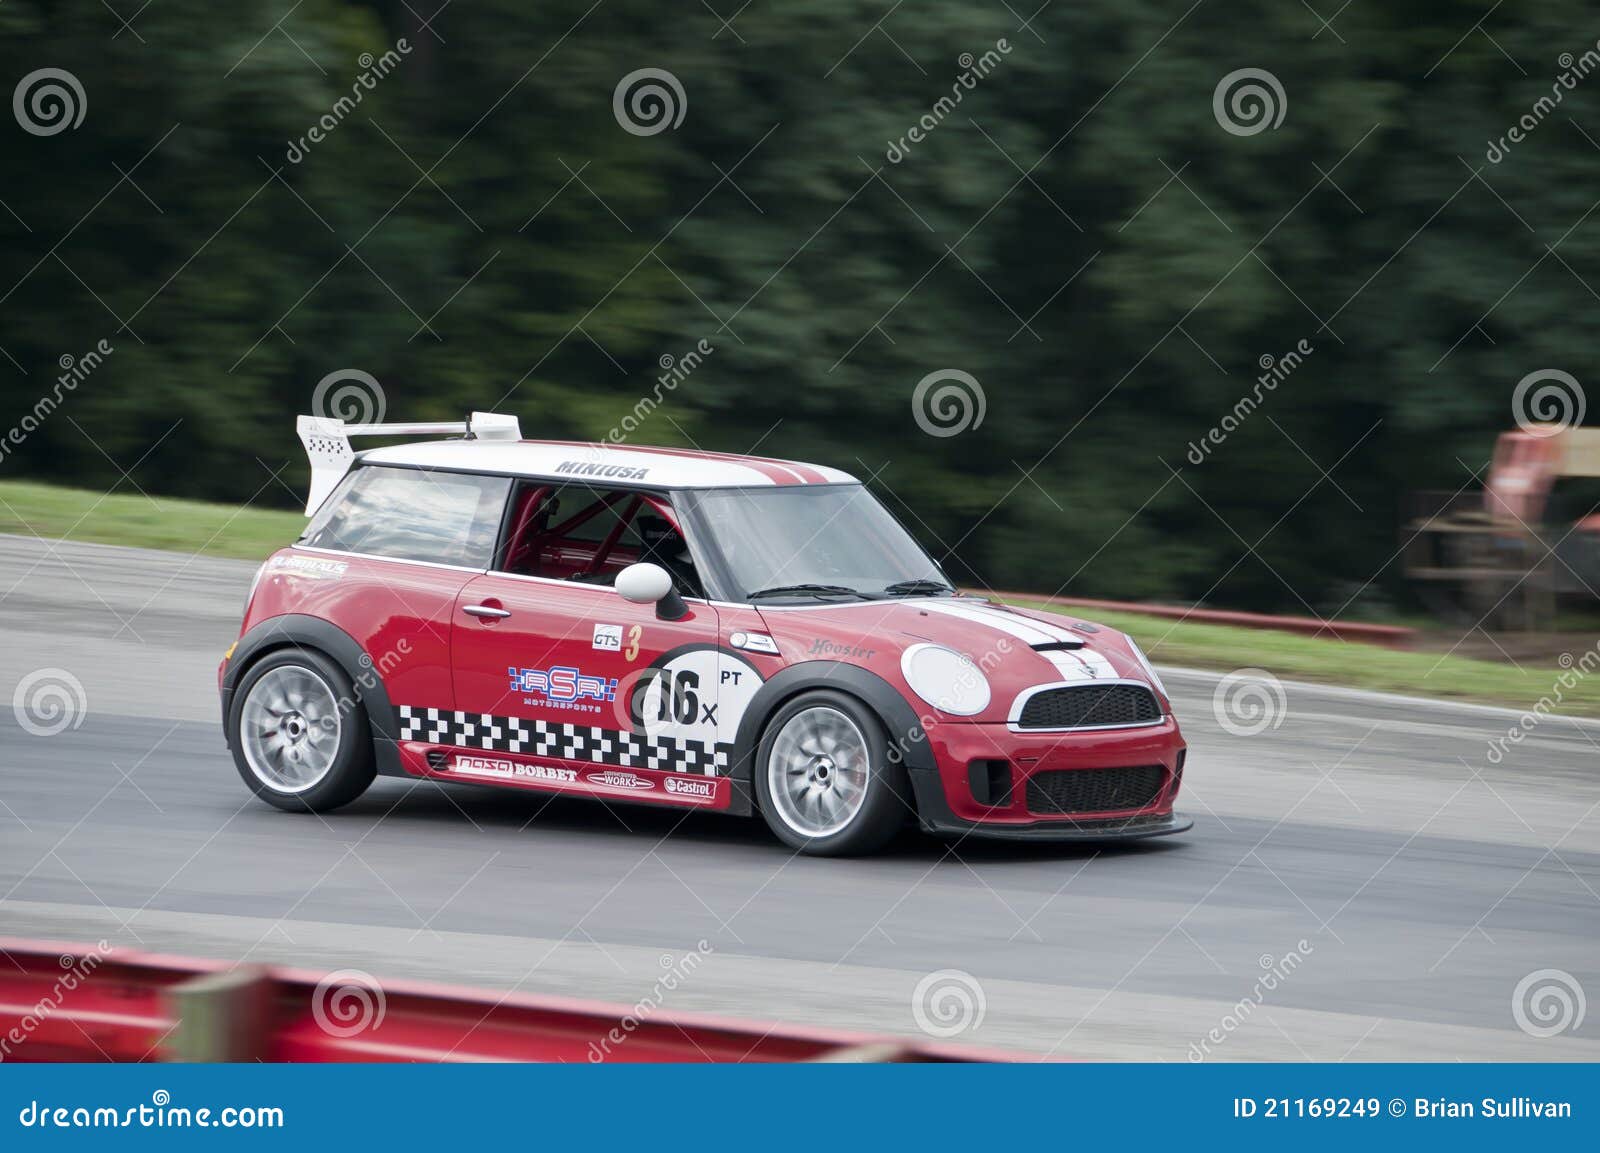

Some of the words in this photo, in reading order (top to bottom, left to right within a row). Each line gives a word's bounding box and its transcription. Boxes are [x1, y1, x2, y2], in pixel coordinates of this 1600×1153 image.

[554, 461, 650, 480] MINIUSA
[594, 634, 619, 647] GTS
[625, 625, 642, 662] 3
[524, 667, 603, 699] RSR
[720, 670, 742, 685] PT
[523, 698, 601, 713] MOTORSPORTS
[514, 763, 577, 782] BORBET
[604, 774, 637, 788] WORKS
[676, 780, 710, 796] Castrol
